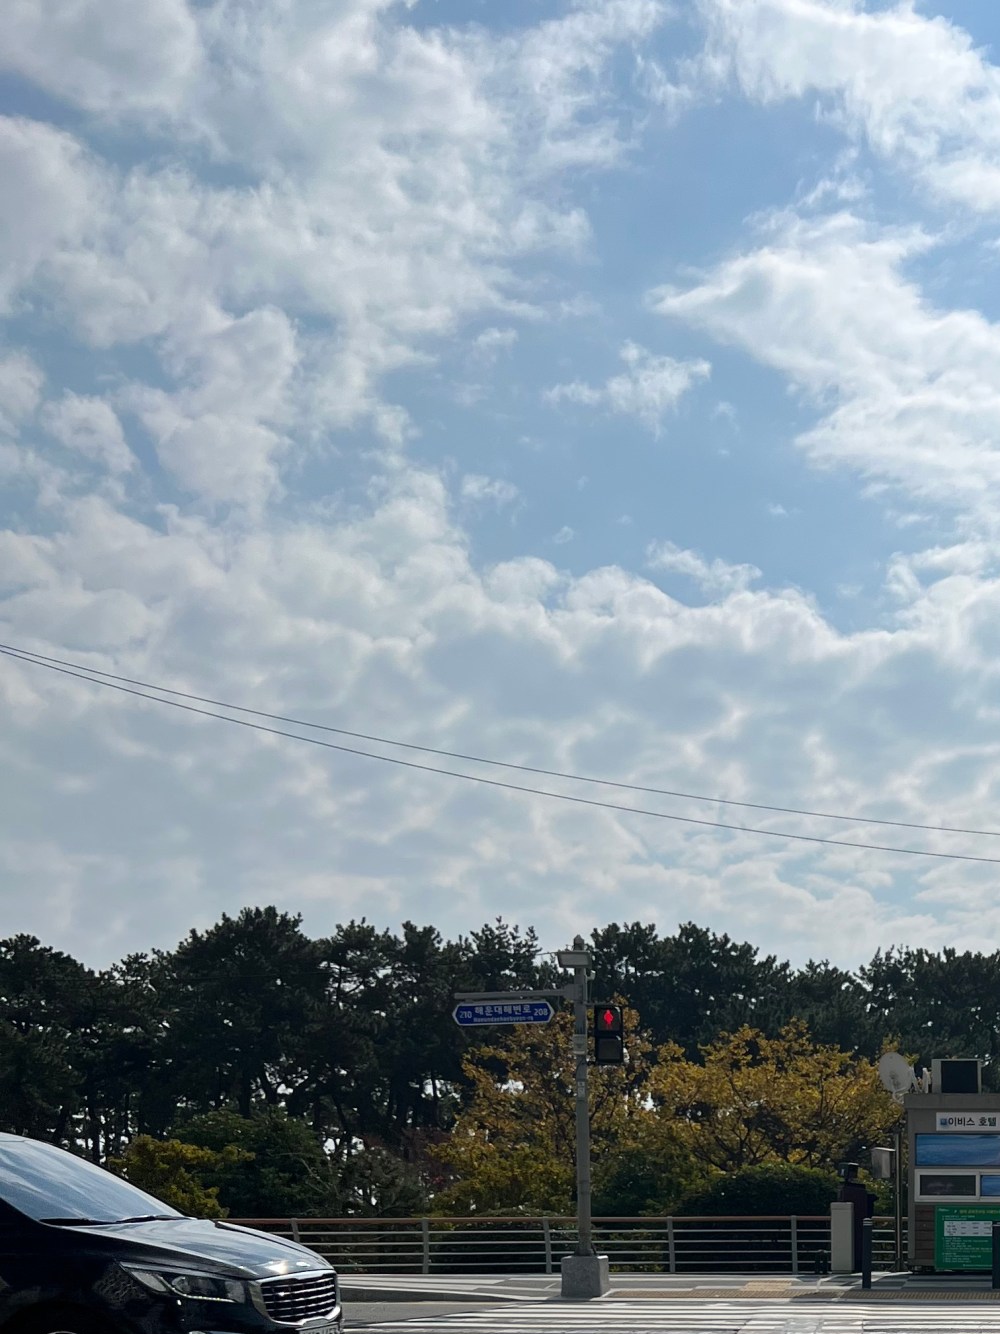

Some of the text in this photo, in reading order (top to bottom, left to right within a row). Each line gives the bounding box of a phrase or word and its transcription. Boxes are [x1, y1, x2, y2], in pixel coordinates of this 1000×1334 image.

[459, 1011, 472, 1019] 210
[474, 1004, 532, 1016] 해운대해변로
[534, 1008, 548, 1016] 208
[948, 1117, 975, 1127] 이비스
[978, 1117, 997, 1127] 호텔
